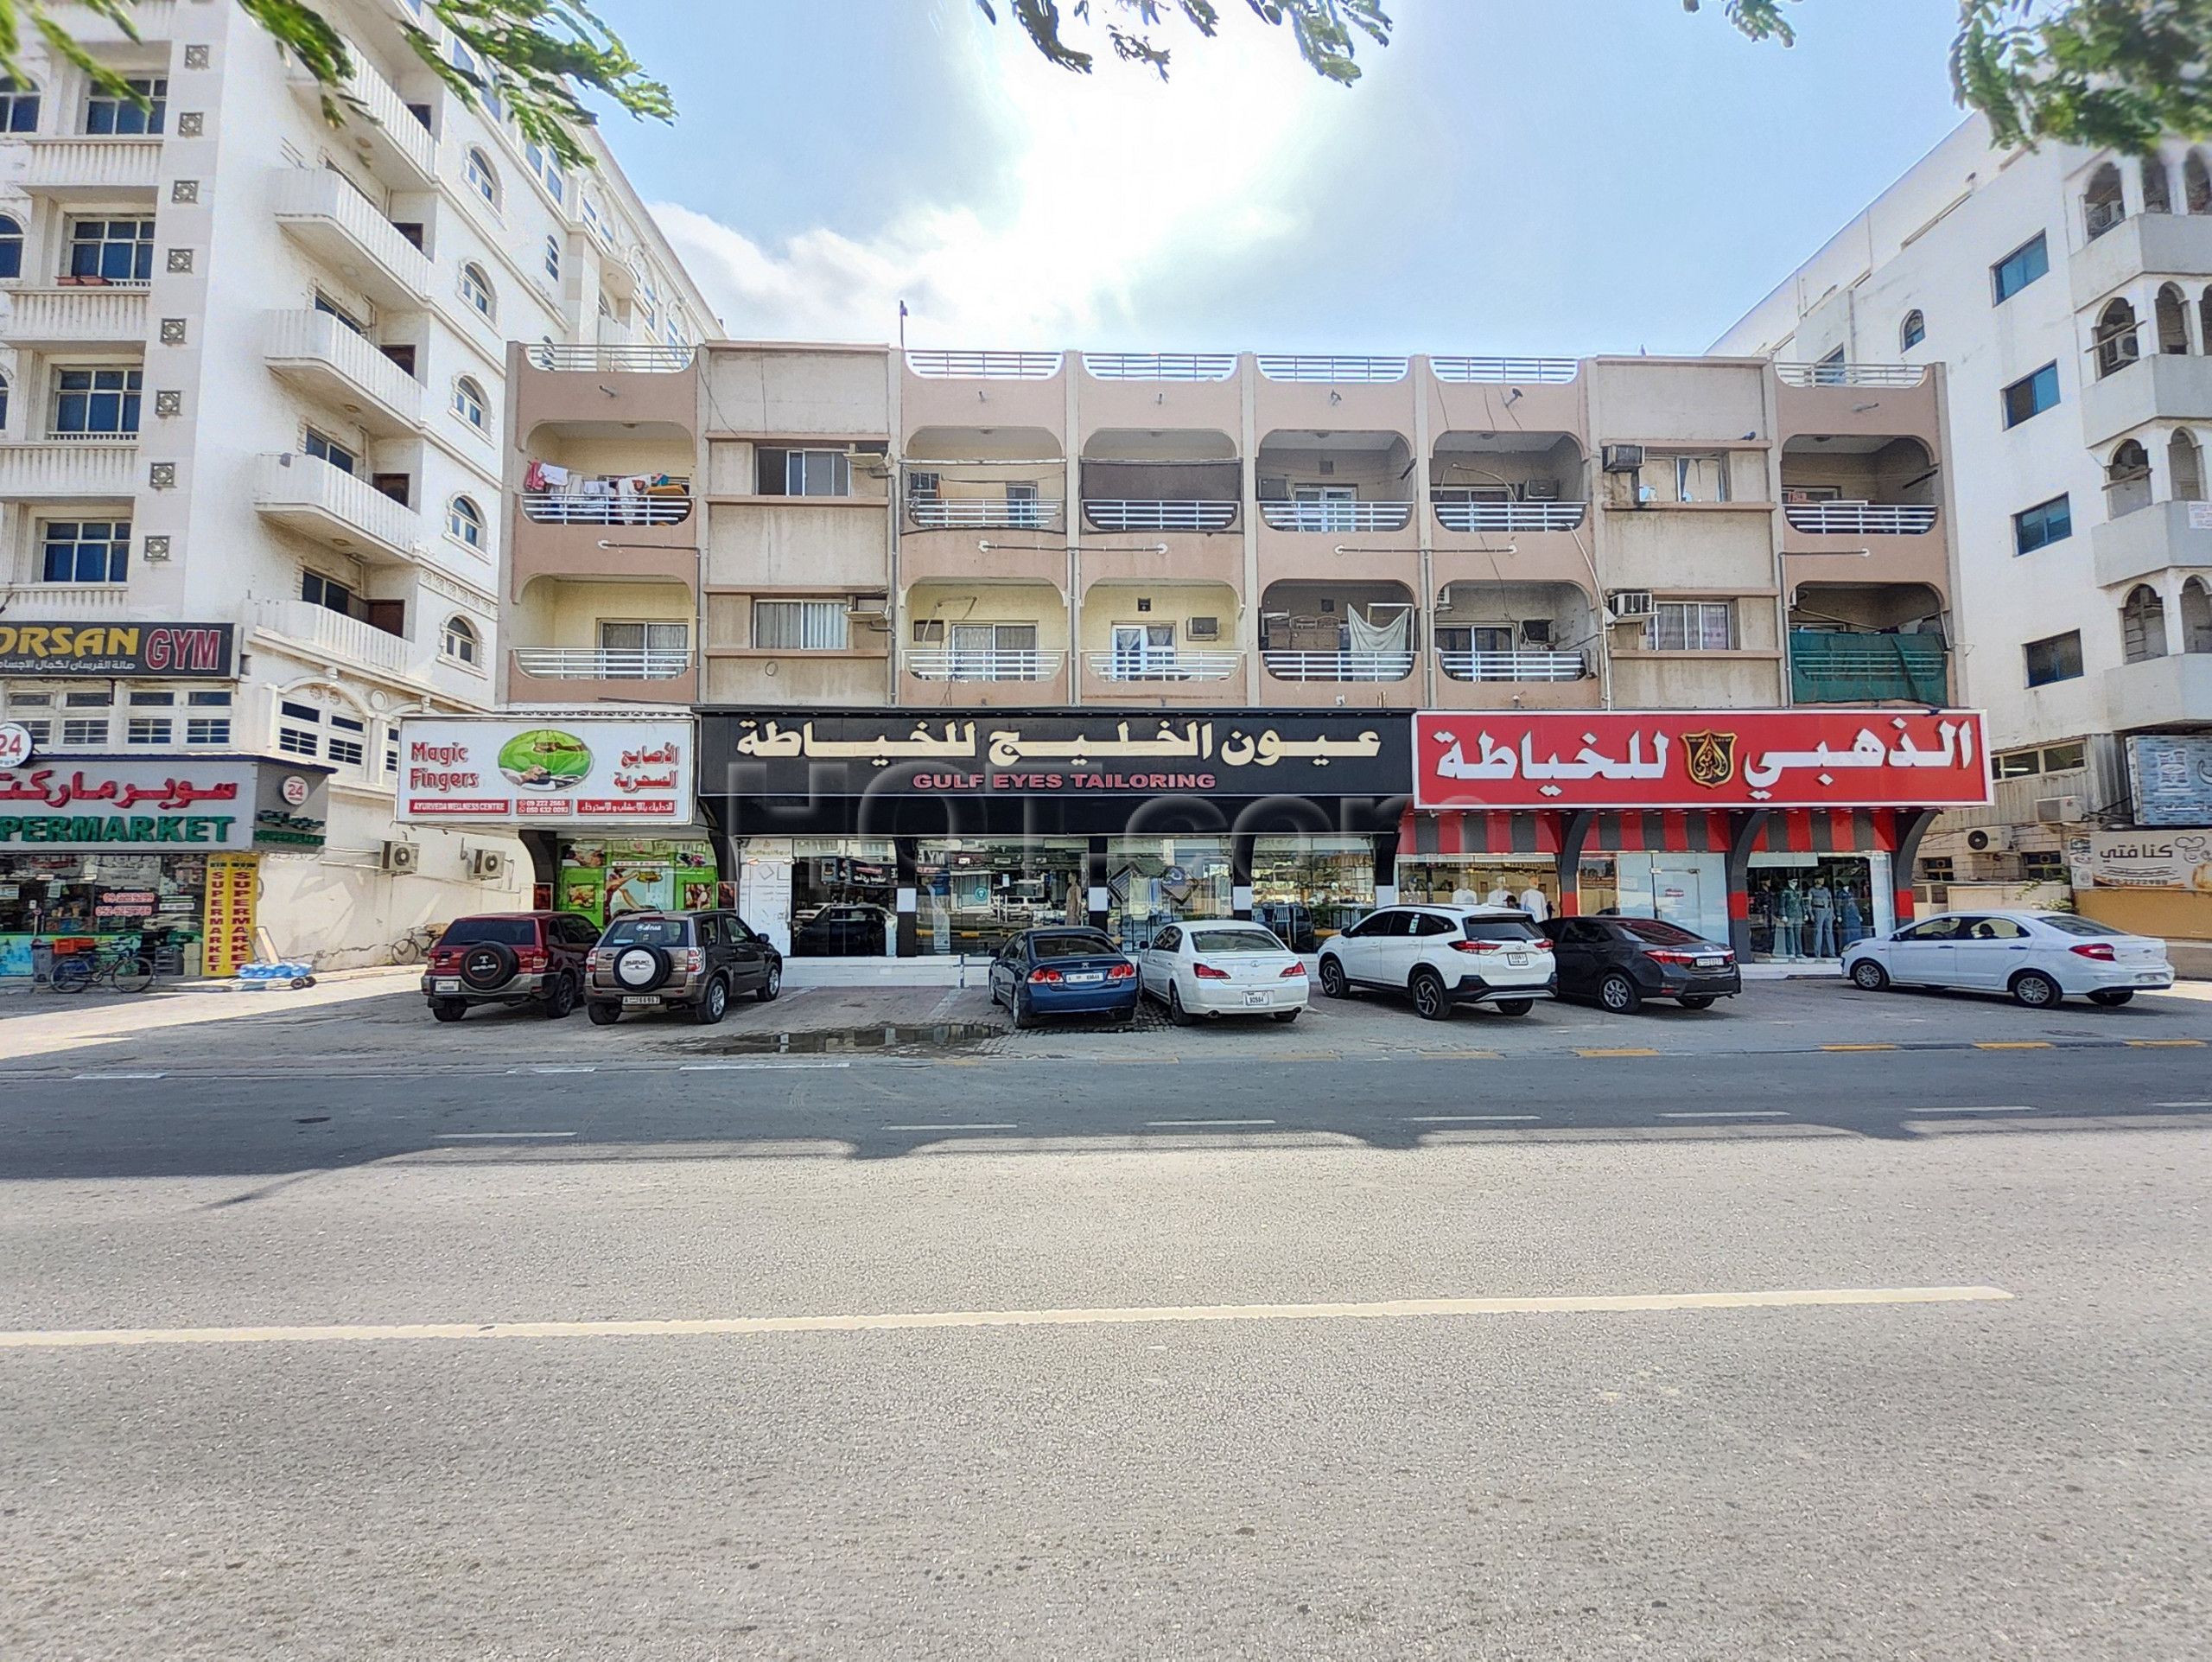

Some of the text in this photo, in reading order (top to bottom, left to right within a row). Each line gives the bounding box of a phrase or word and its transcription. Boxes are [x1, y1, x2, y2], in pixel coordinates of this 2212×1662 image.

[145, 628, 221, 670] GYM
[411, 742, 468, 767] Magic
[736, 719, 1382, 767] عيون الخليج للخياطة
[1433, 729, 1669, 797] للخياطة
[1743, 716, 1974, 800] الذهبي
[288, 783, 304, 797] 24
[410, 767, 480, 793] Fingers
[912, 774, 1217, 789] GULF EYES TAILORING
[413, 802, 505, 811] AYURVEDA WELLNESS CENTRE
[2100, 844, 2173, 863] كنافتي
[208, 871, 225, 971] SUPERMARKET
